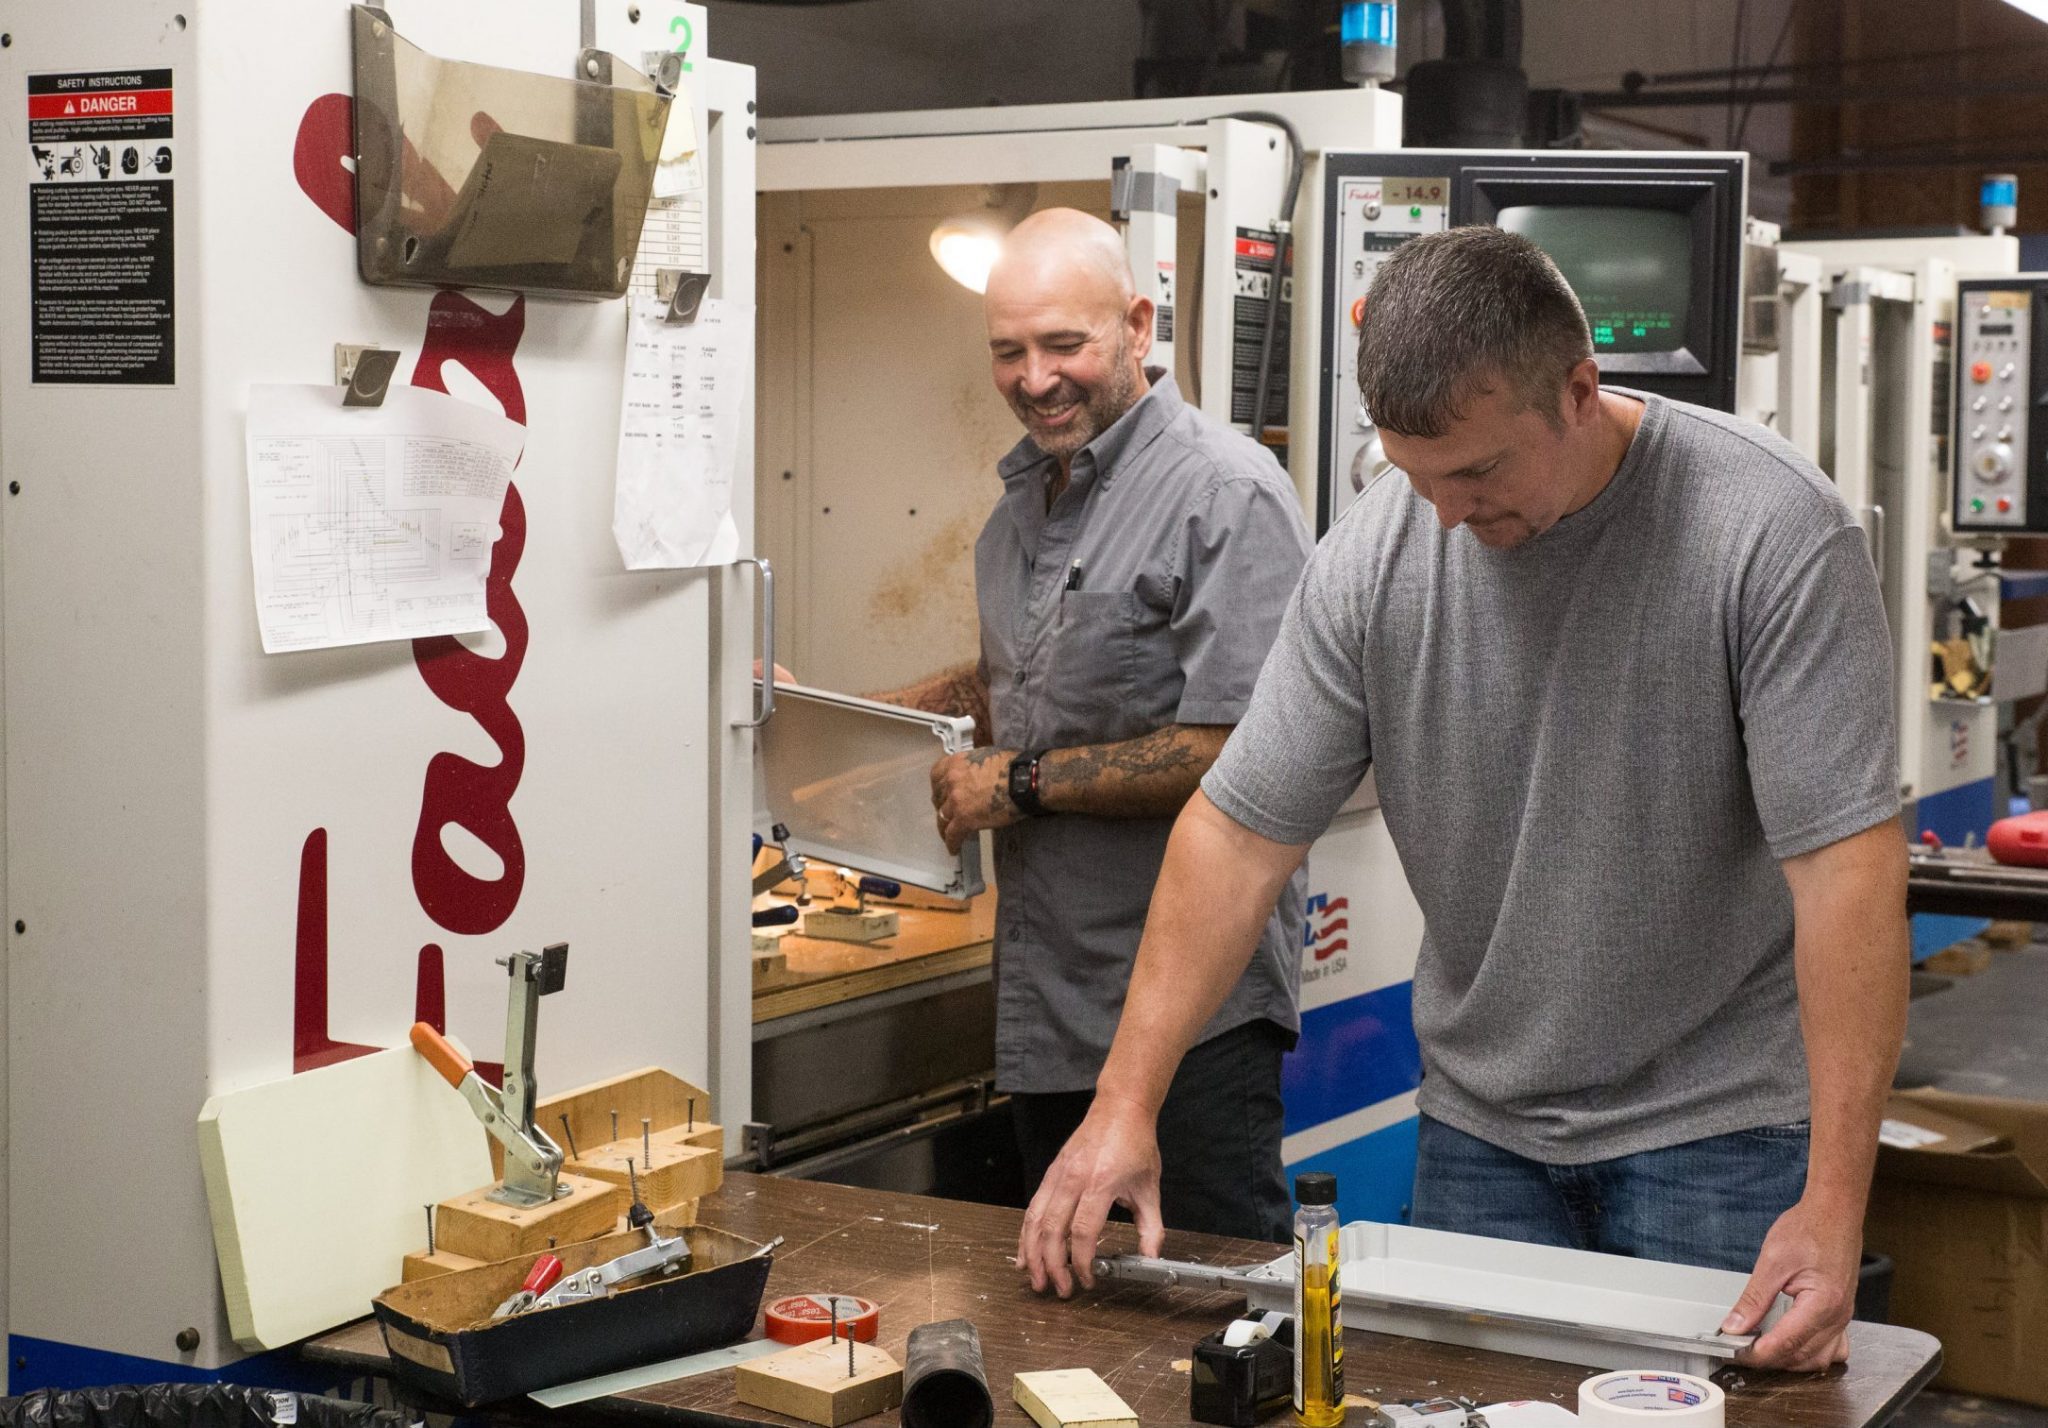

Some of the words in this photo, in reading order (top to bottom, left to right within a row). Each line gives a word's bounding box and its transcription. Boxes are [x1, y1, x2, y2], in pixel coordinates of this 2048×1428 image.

[669, 16, 692, 72] 2
[57, 79, 85, 89] SAFETY
[88, 75, 142, 87] INSTRUCTIONS
[80, 96, 137, 113] DANGER
[1348, 189, 1381, 200] Fadal
